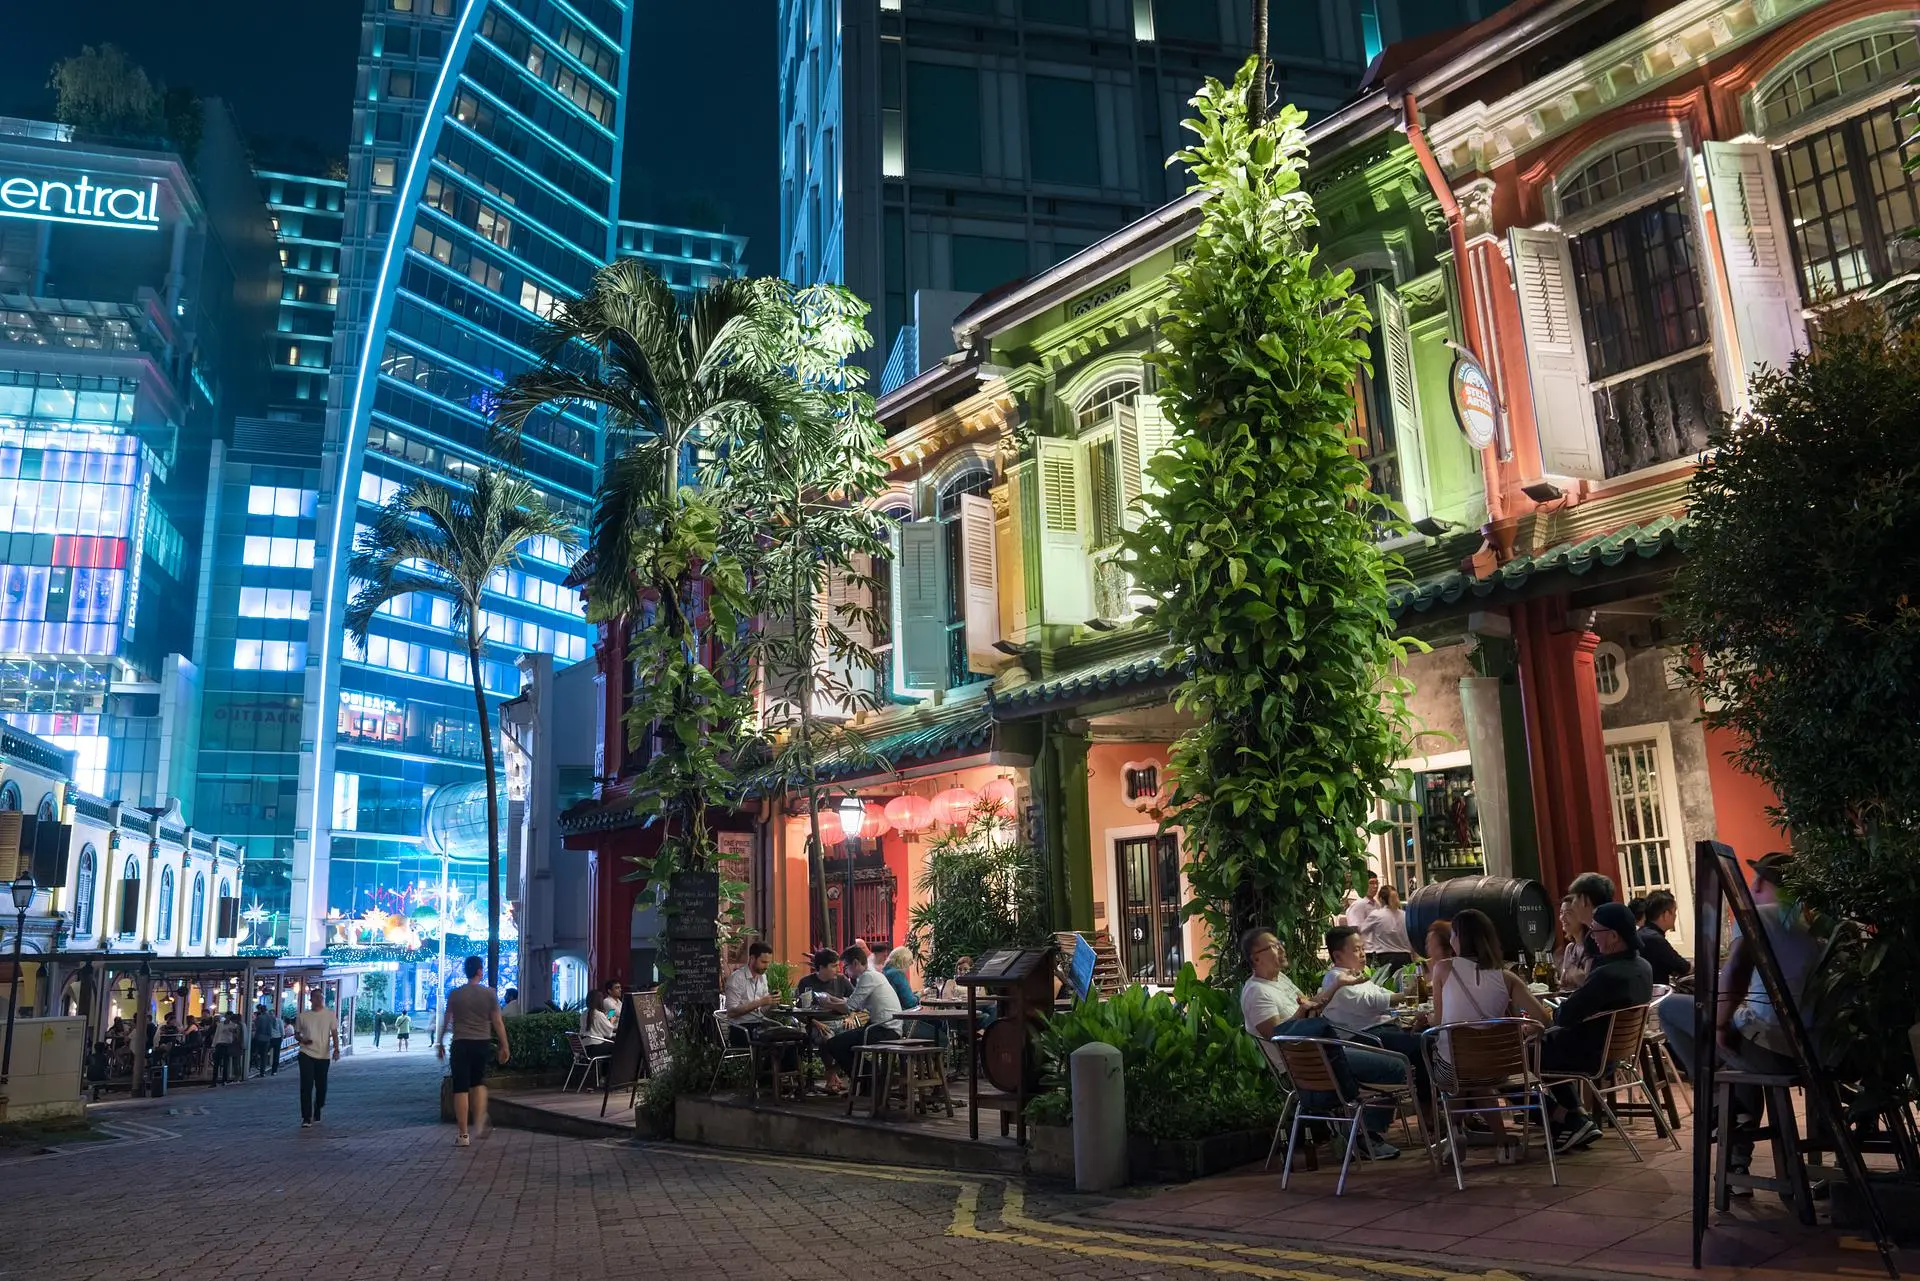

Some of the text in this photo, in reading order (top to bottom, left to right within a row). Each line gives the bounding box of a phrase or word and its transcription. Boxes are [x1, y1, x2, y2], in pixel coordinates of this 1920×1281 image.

[0, 176, 160, 221] entral
[340, 691, 397, 712] OUTBACK
[214, 708, 301, 724] OUTBACK
